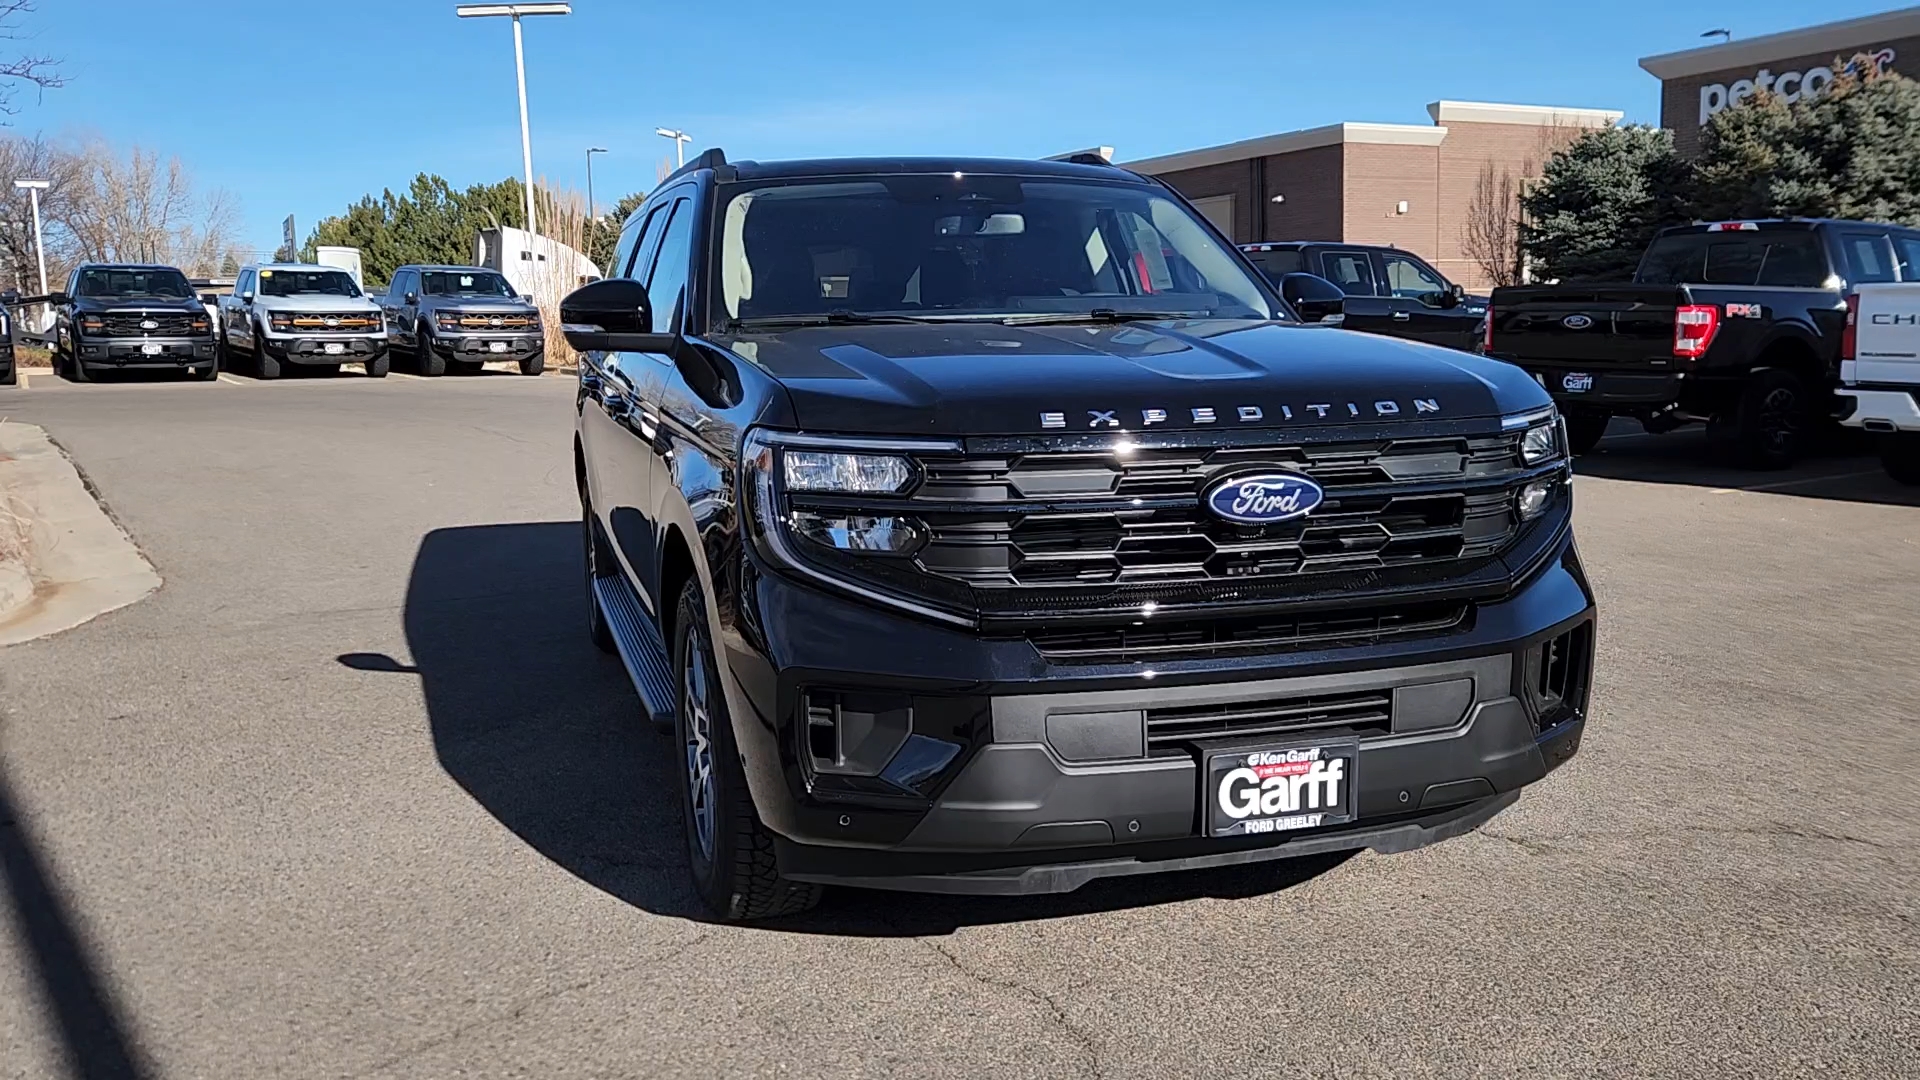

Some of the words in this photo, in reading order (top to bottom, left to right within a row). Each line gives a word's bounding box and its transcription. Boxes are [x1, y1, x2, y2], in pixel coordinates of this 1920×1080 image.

[1700, 67, 1833, 126] petco
[1726, 303, 1761, 318] FX4
[1562, 375, 1592, 390] Garff
[1039, 398, 1440, 428] EXPEDITION
[1231, 482, 1301, 515] Ford
[1261, 751, 1286, 766] Ken
[1287, 748, 1320, 763] Garff
[1218, 758, 1343, 819] Garff
[1245, 819, 1274, 834] FORD
[1276, 814, 1322, 832] GREELEY
